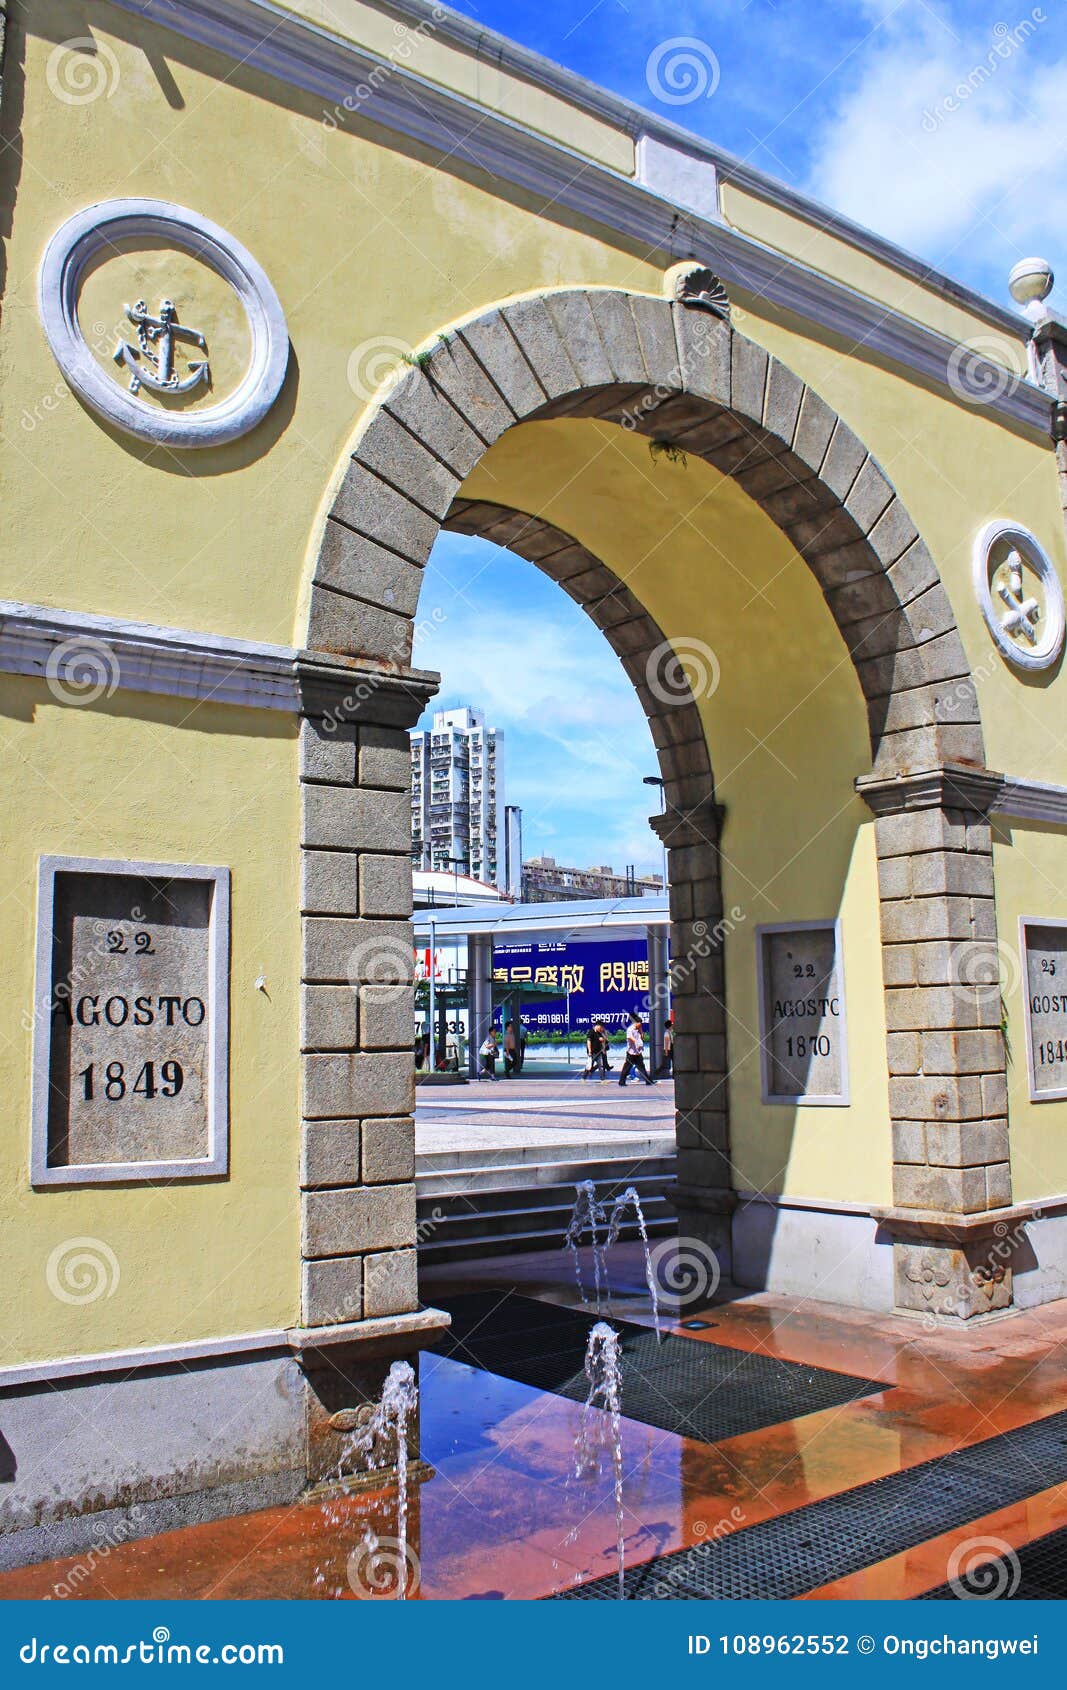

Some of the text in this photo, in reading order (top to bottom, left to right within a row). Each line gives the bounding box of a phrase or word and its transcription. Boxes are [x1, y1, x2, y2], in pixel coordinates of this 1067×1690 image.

[107, 931, 155, 955] 22
[793, 963, 816, 978] 22
[1041, 958, 1056, 976] 25
[52, 995, 206, 1027] AGOSTO
[1030, 994, 1067, 1014] GOST
[785, 1035, 830, 1058] 1870
[78, 1060, 184, 1101] 1849
